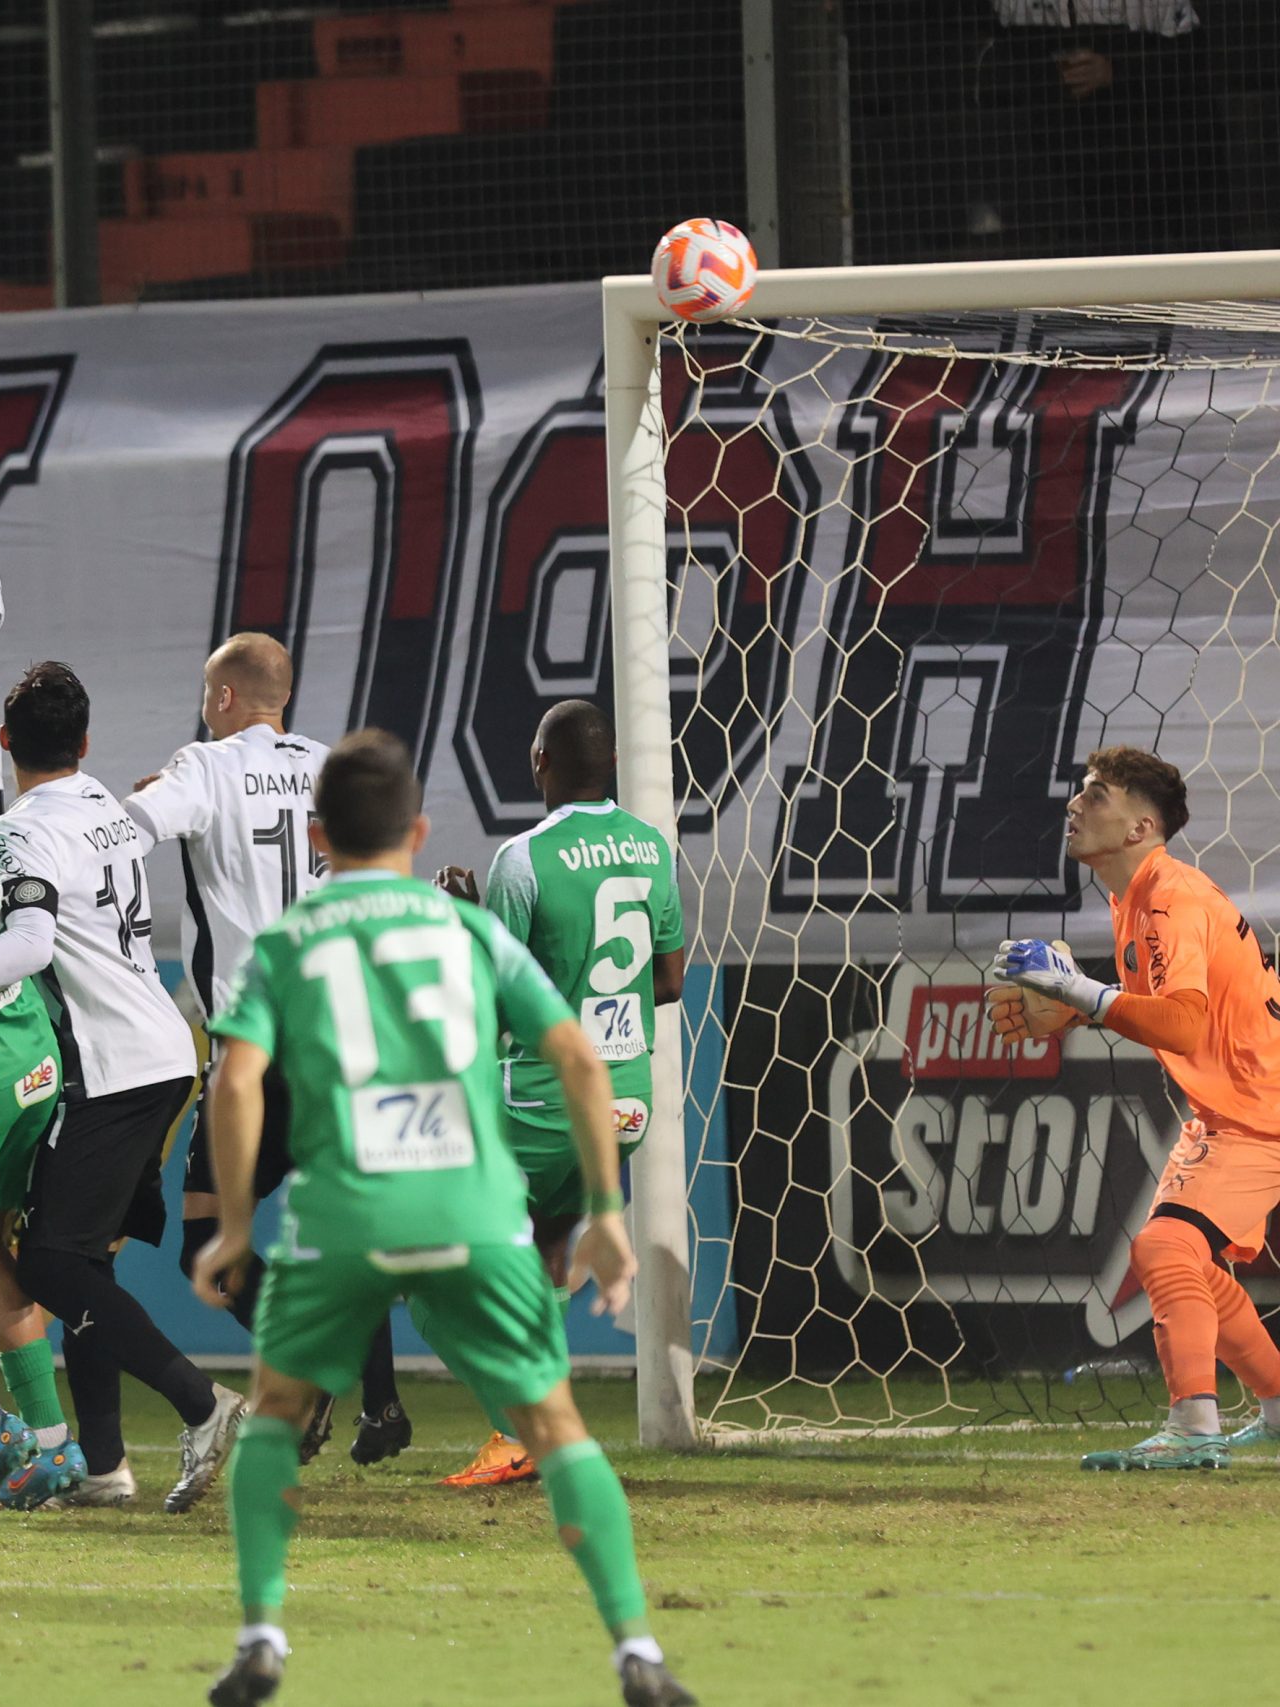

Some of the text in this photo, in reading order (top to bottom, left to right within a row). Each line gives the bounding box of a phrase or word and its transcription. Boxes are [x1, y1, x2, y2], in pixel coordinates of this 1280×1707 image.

[245, 773, 314, 796] DIAMA
[83, 818, 137, 853] VOUROS
[559, 834, 660, 871] vinicius
[96, 857, 152, 960] 14
[589, 876, 653, 994] 5
[593, 1039, 646, 1058] ompotis
